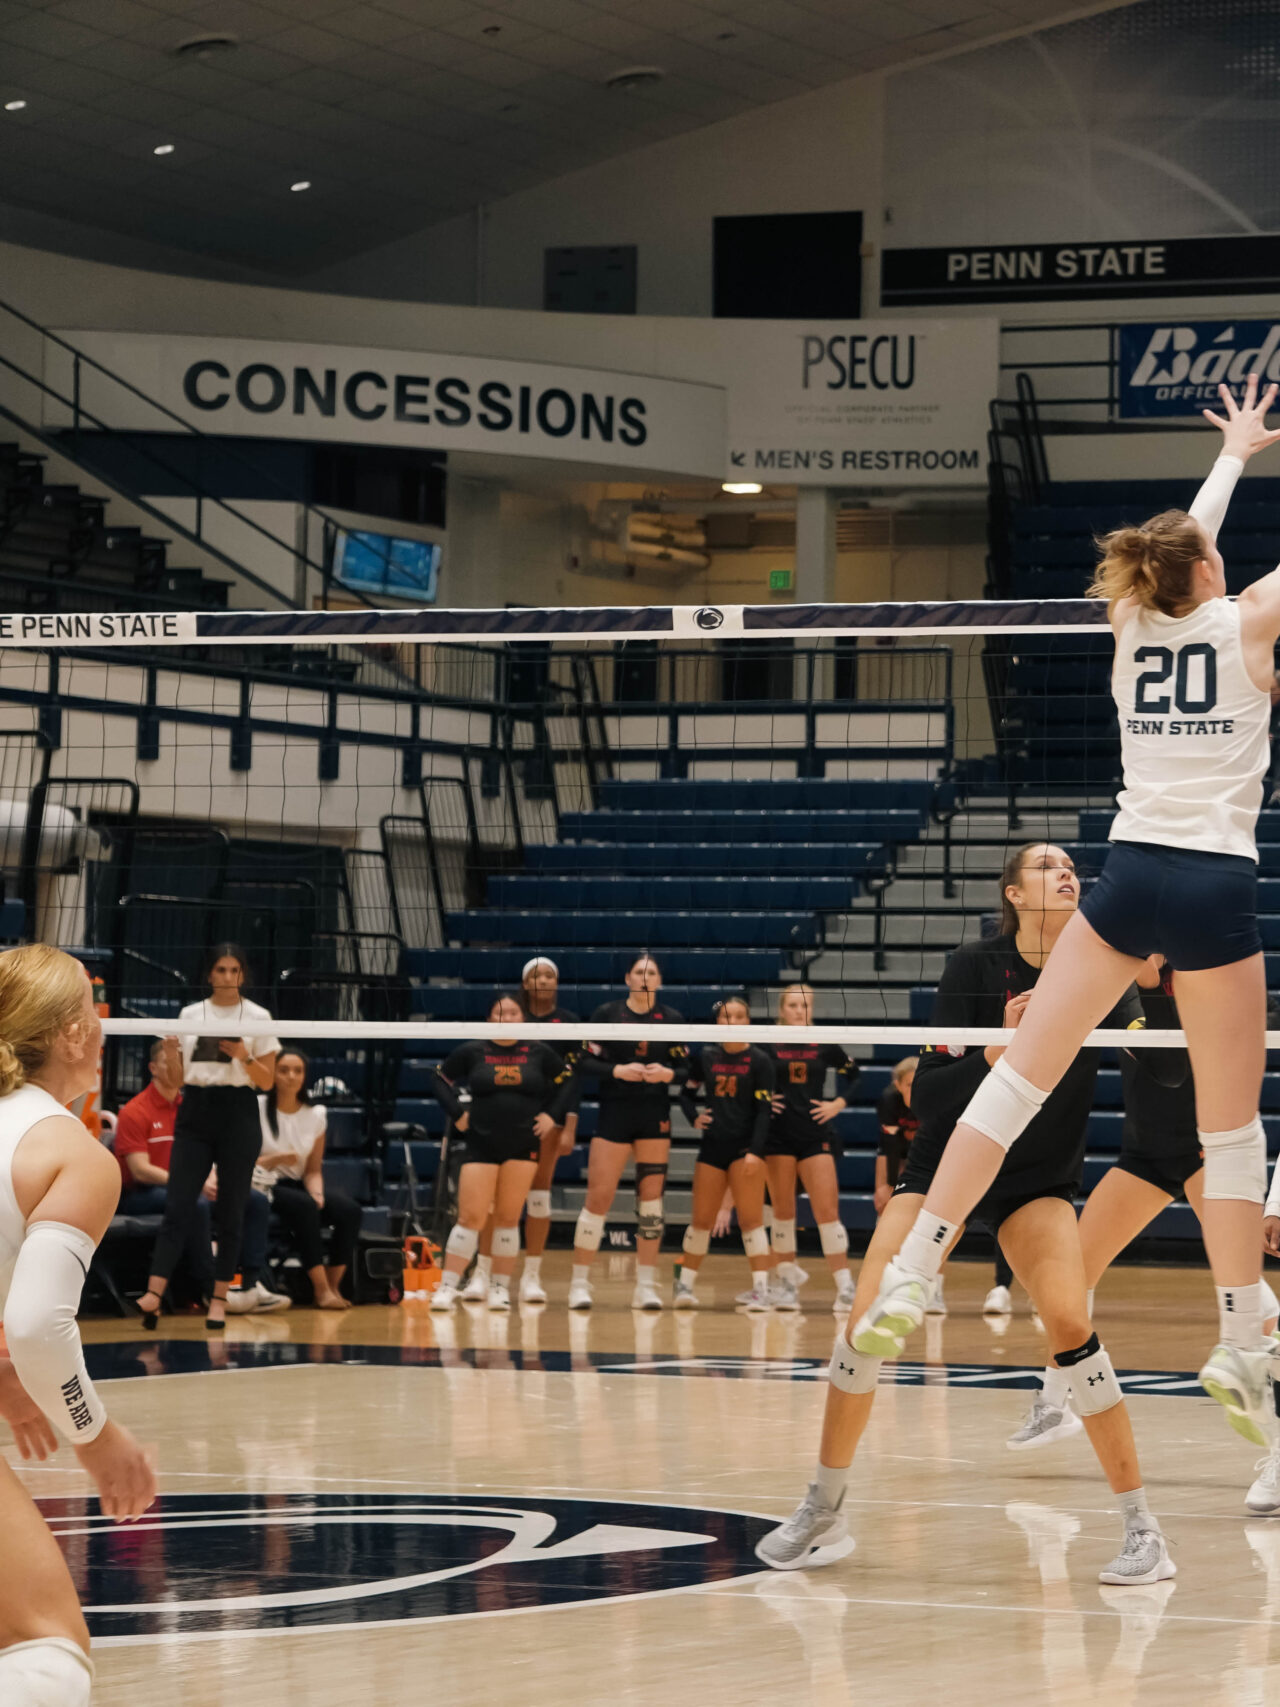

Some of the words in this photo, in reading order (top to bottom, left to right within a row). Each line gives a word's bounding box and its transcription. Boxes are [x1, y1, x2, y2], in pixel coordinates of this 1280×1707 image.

[947, 251, 1042, 281] PENN
[1055, 247, 1166, 278] STATE
[802, 335, 915, 389] PSECU
[182, 360, 648, 446] CONCESSIONS
[755, 450, 833, 470] MEN'S
[842, 450, 979, 470] RESTROOM
[22, 616, 91, 638] PENN
[99, 614, 178, 638] STATE
[1134, 643, 1216, 714] 20
[1169, 719, 1234, 735] STATE
[714, 1075, 737, 1097] 24
[61, 1374, 84, 1406] WE
[69, 1399, 94, 1431] ARE
